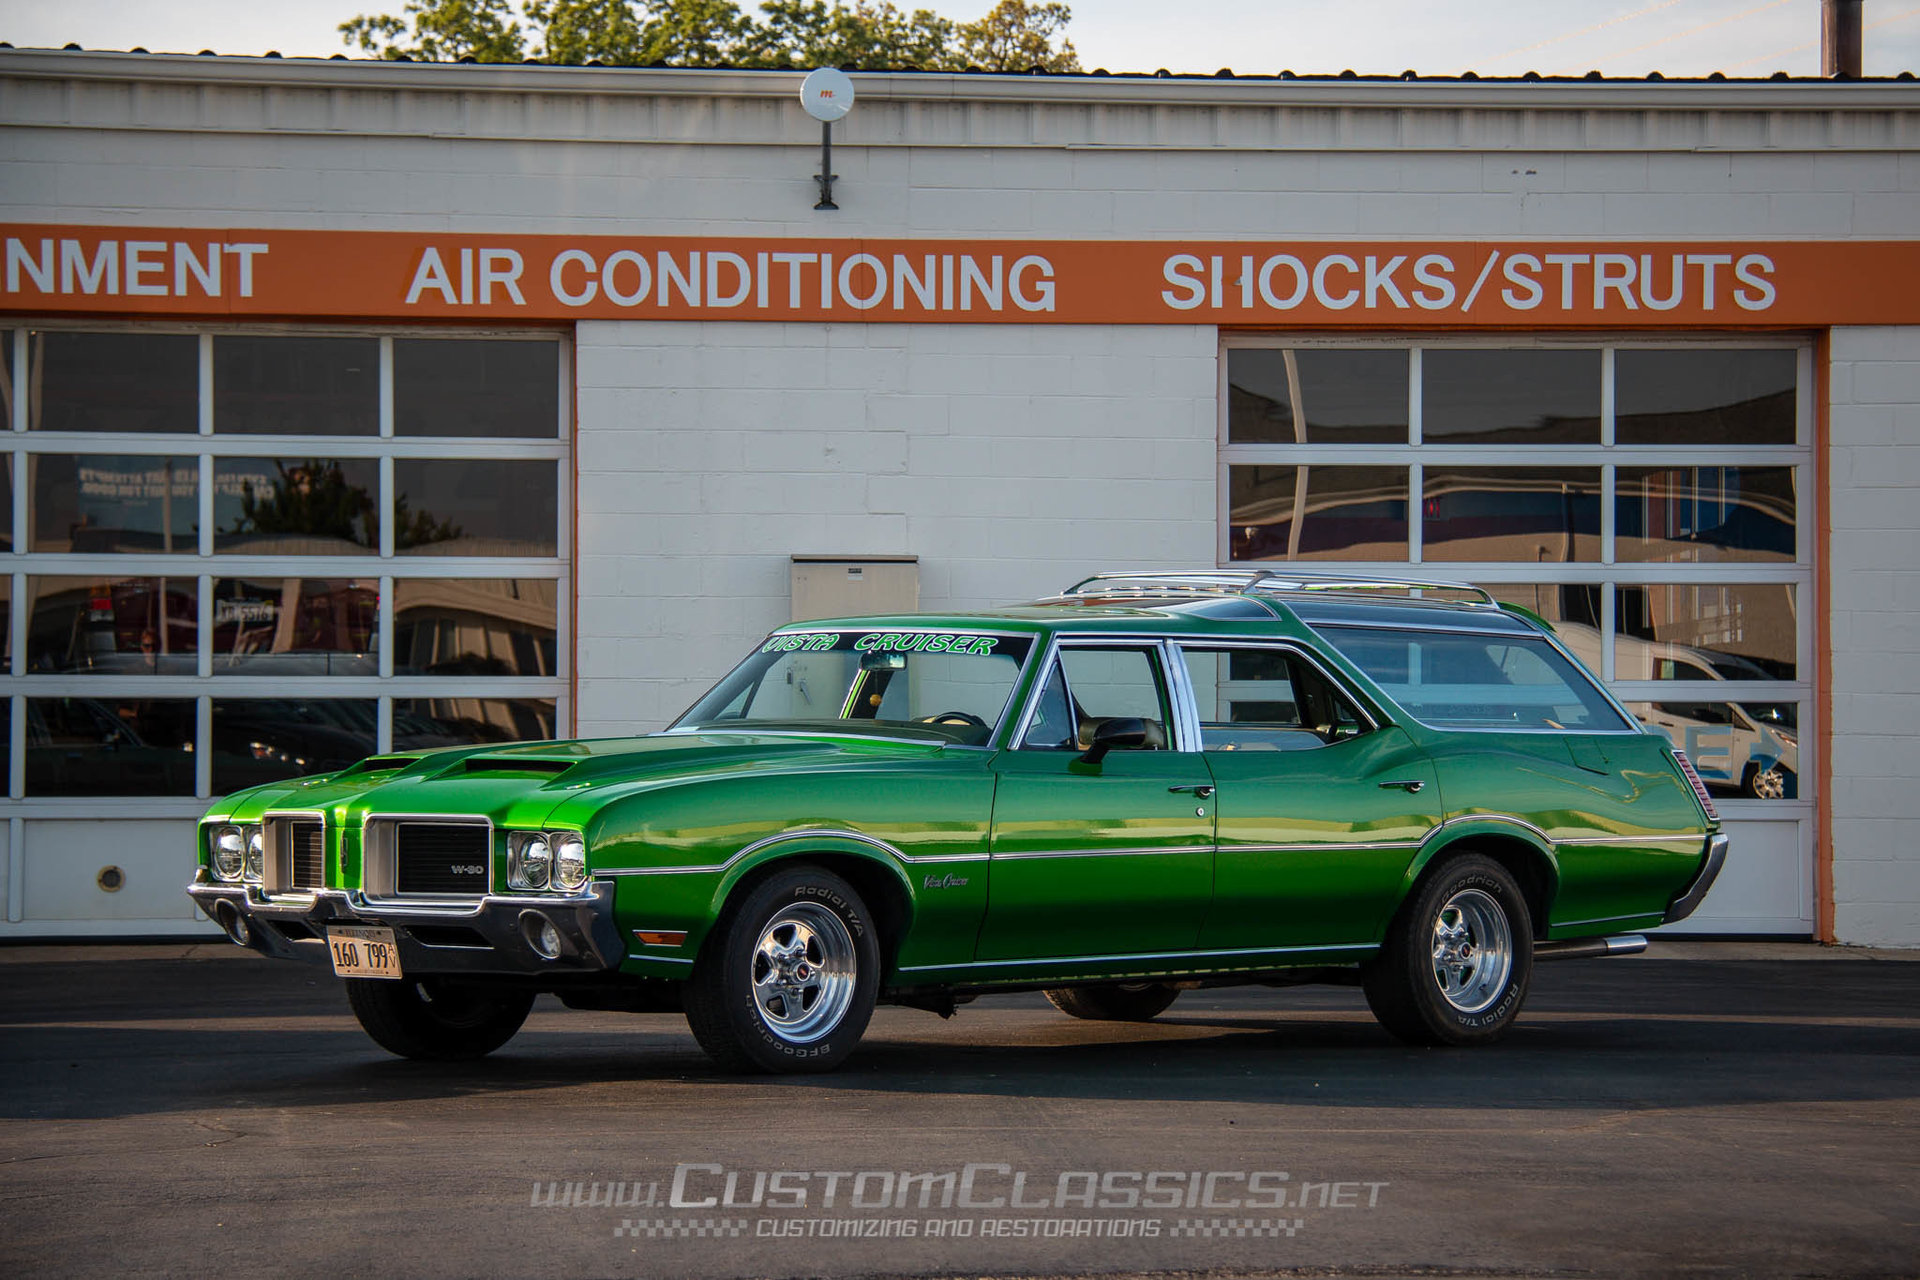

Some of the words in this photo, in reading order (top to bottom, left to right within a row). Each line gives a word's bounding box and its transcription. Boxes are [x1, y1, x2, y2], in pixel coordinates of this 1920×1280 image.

[5, 238, 269, 297] NMENT
[405, 247, 527, 305] AIR
[550, 249, 1057, 312] CONDITIONING
[1161, 250, 1777, 313] SHOCKS/STRUTS
[762, 633, 840, 653] VISTA
[853, 633, 999, 656] CRUISER
[794, 885, 848, 909] Radial
[848, 908, 864, 937] T/A
[333, 942, 359, 967] 160
[363, 943, 388, 968] 799
[745, 994, 831, 1058] BFGoodrich
[1457, 1015, 1479, 1027] T/A
[1481, 983, 1519, 1026] Radial
